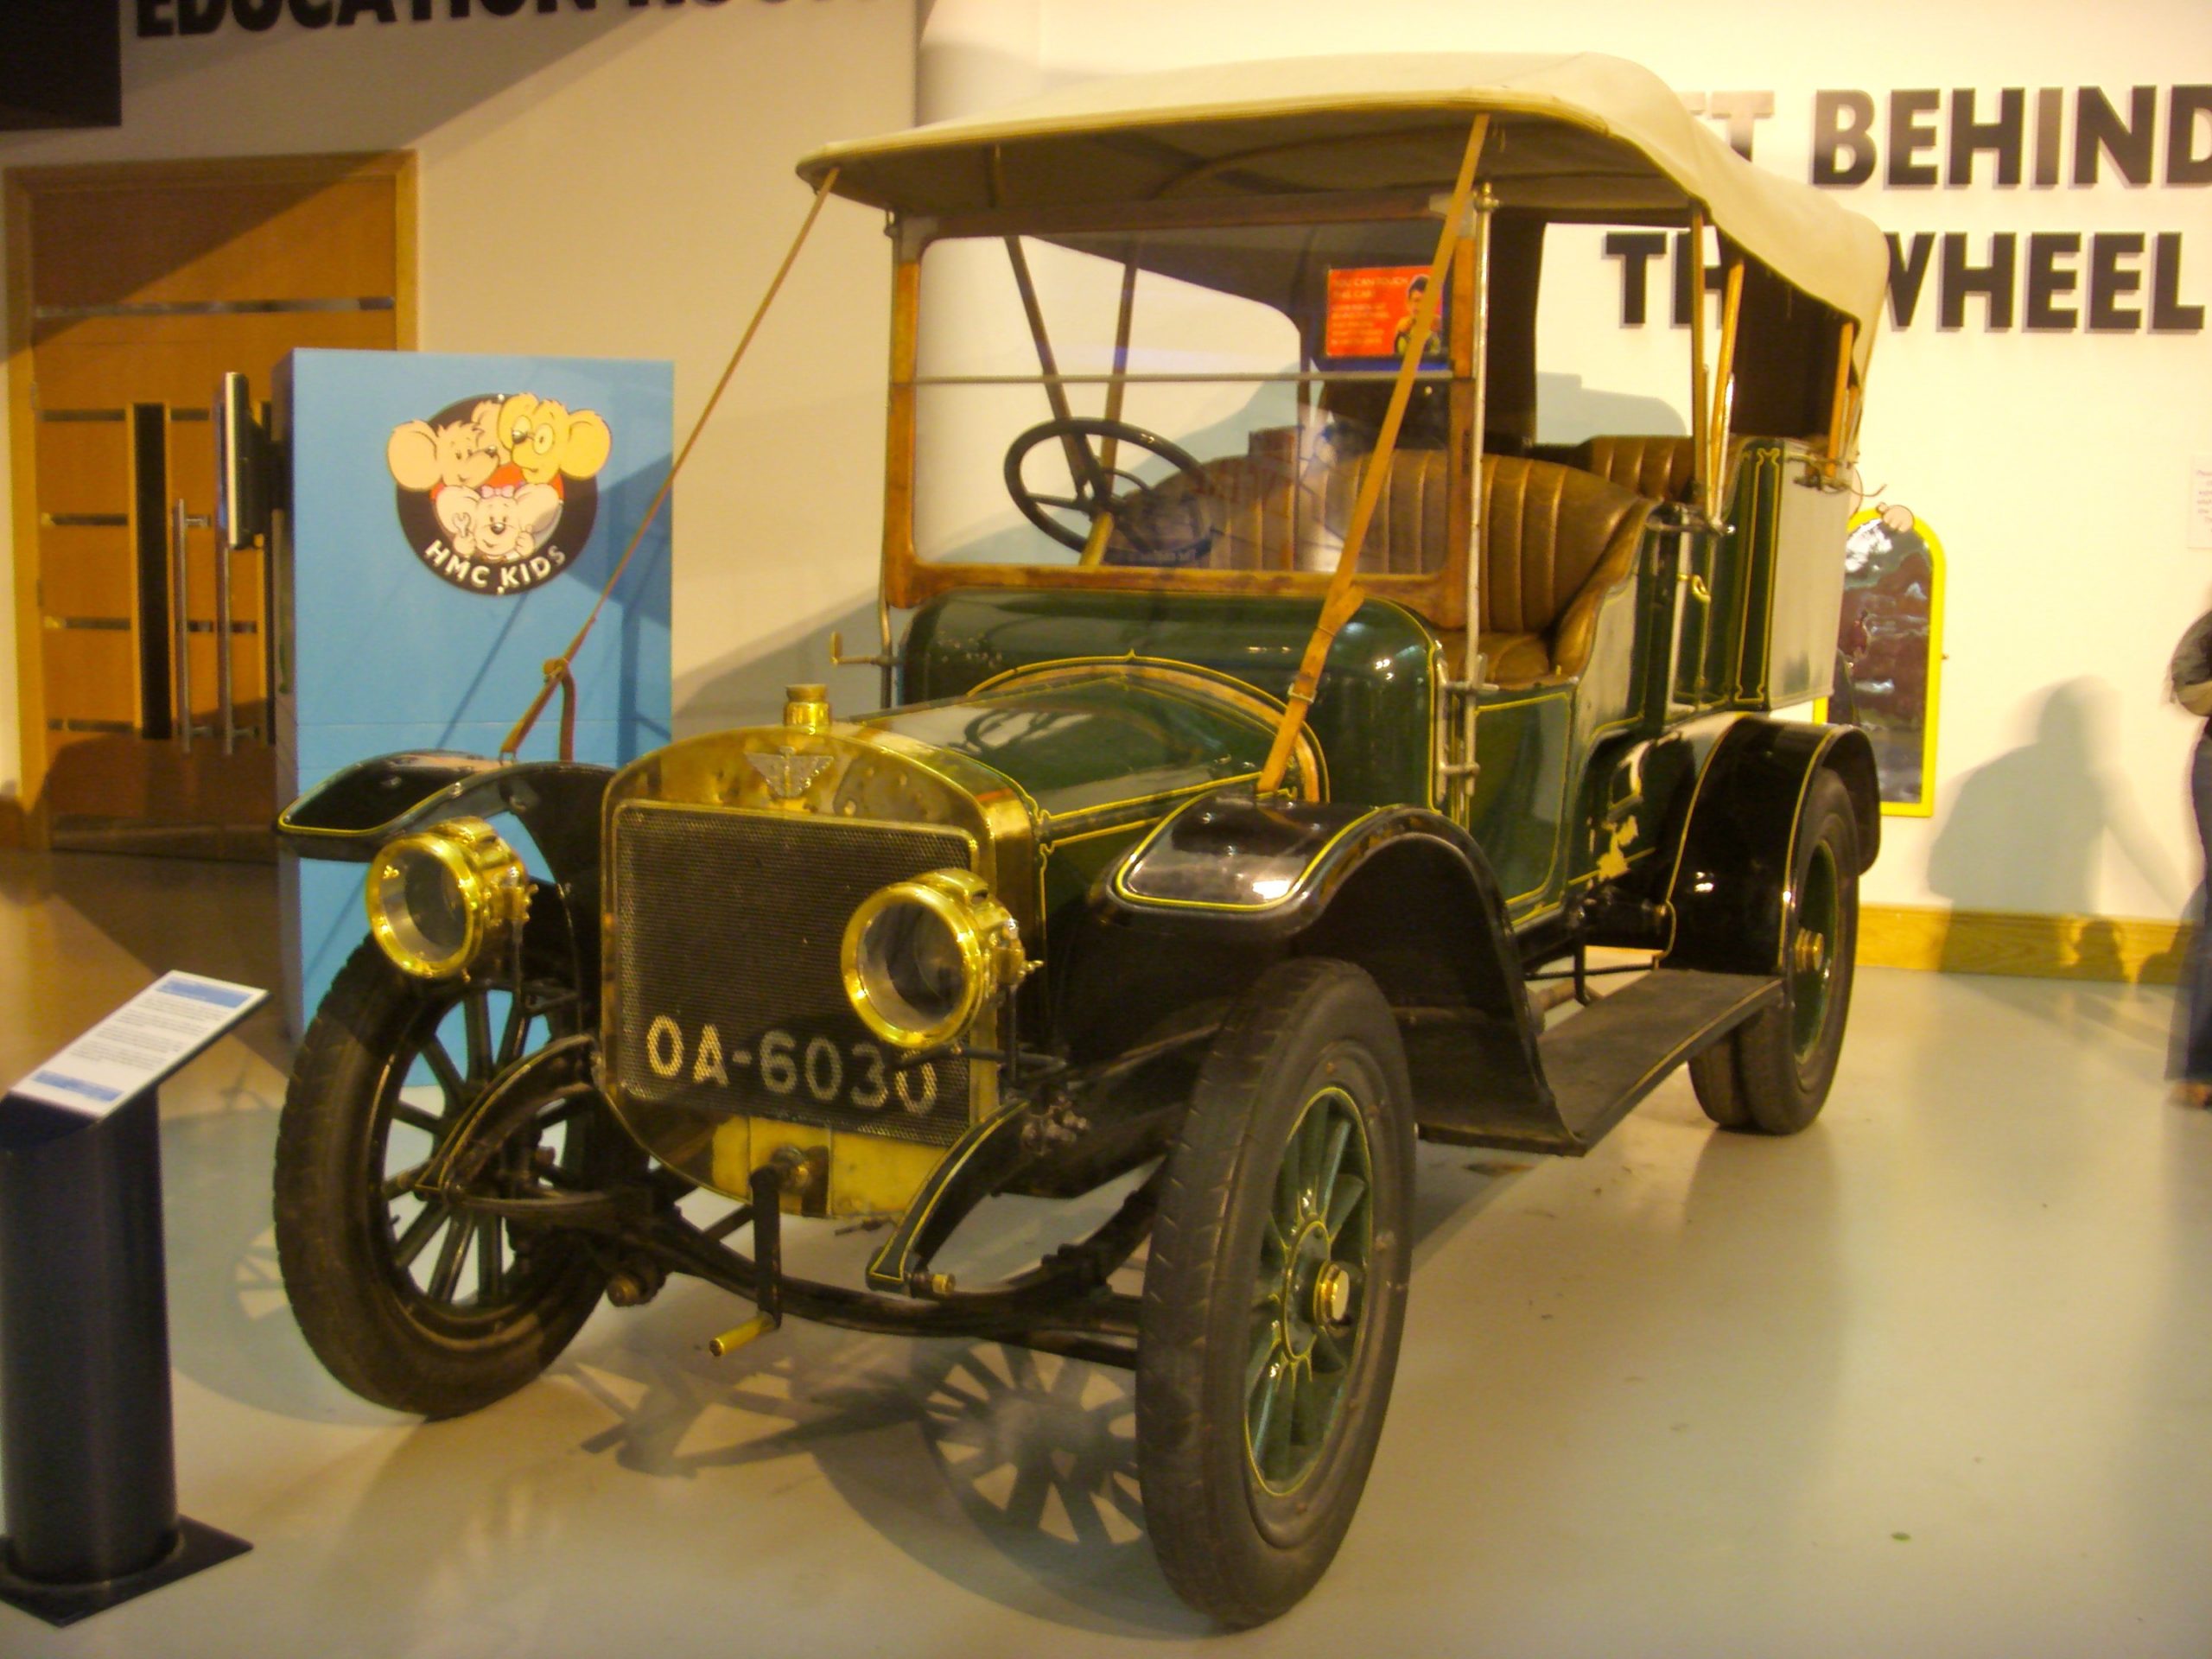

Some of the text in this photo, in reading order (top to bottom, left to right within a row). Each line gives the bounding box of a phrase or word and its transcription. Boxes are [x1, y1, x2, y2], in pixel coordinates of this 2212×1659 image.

[1812, 84, 2212, 187] BEHIND
[1605, 231, 1724, 327] TH
[423, 538, 566, 588] HMC KIDS
